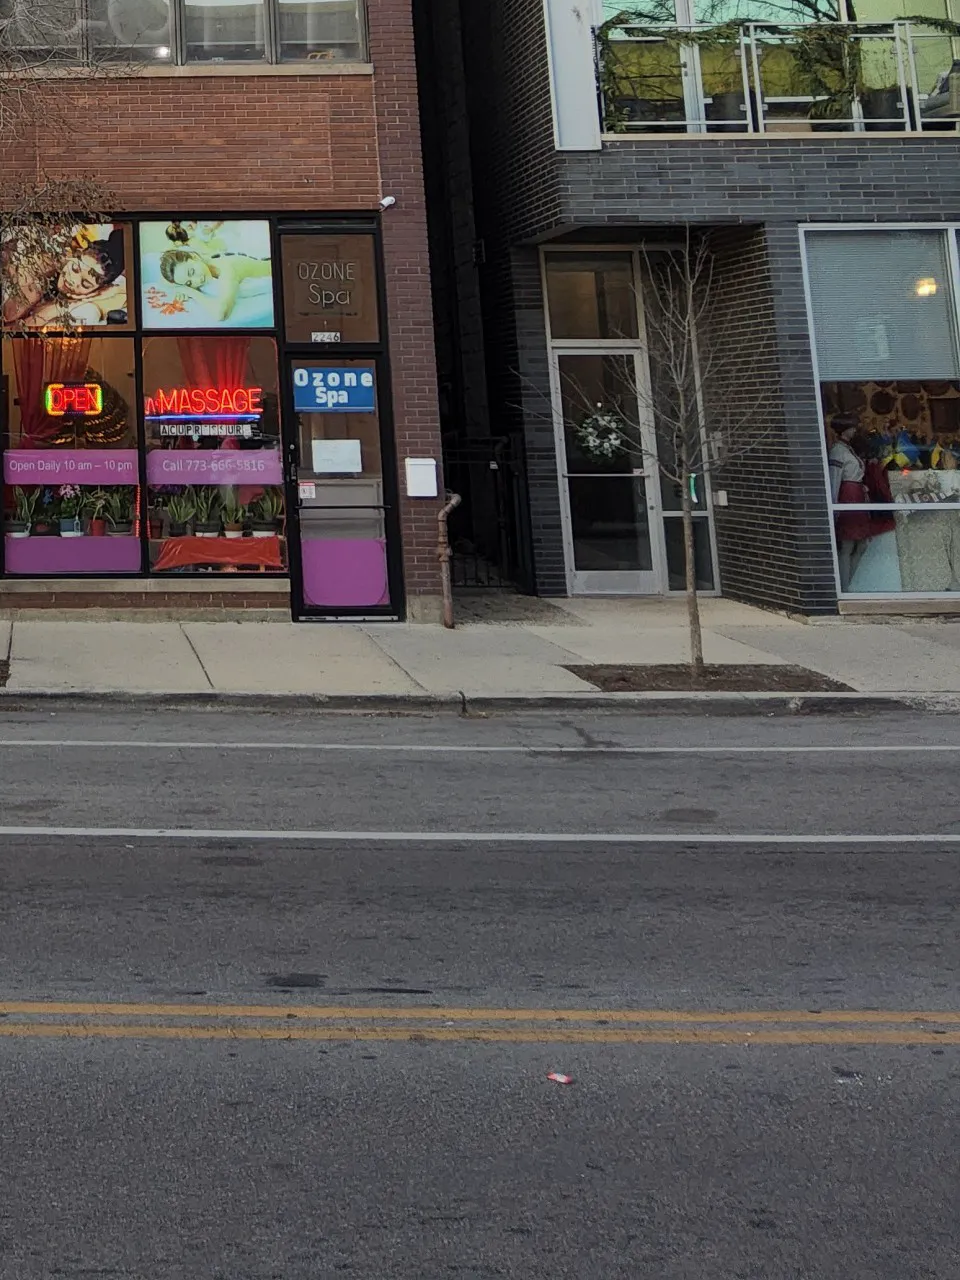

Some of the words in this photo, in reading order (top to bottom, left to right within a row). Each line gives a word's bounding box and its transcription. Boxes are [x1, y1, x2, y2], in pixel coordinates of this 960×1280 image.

[298, 262, 356, 281] OZONE
[308, 283, 351, 308] Spa
[294, 368, 373, 387] Ozone
[52, 388, 100, 410] OPEN
[159, 388, 264, 413] MASSAGE
[315, 387, 349, 408] Spa
[9, 460, 35, 472] Open
[37, 460, 61, 472] Daily
[64, 460, 75, 470] 10
[77, 462, 92, 470] am
[104, 460, 116, 470] 10
[118, 462, 132, 472] pm
[162, 460, 183, 471] Call
